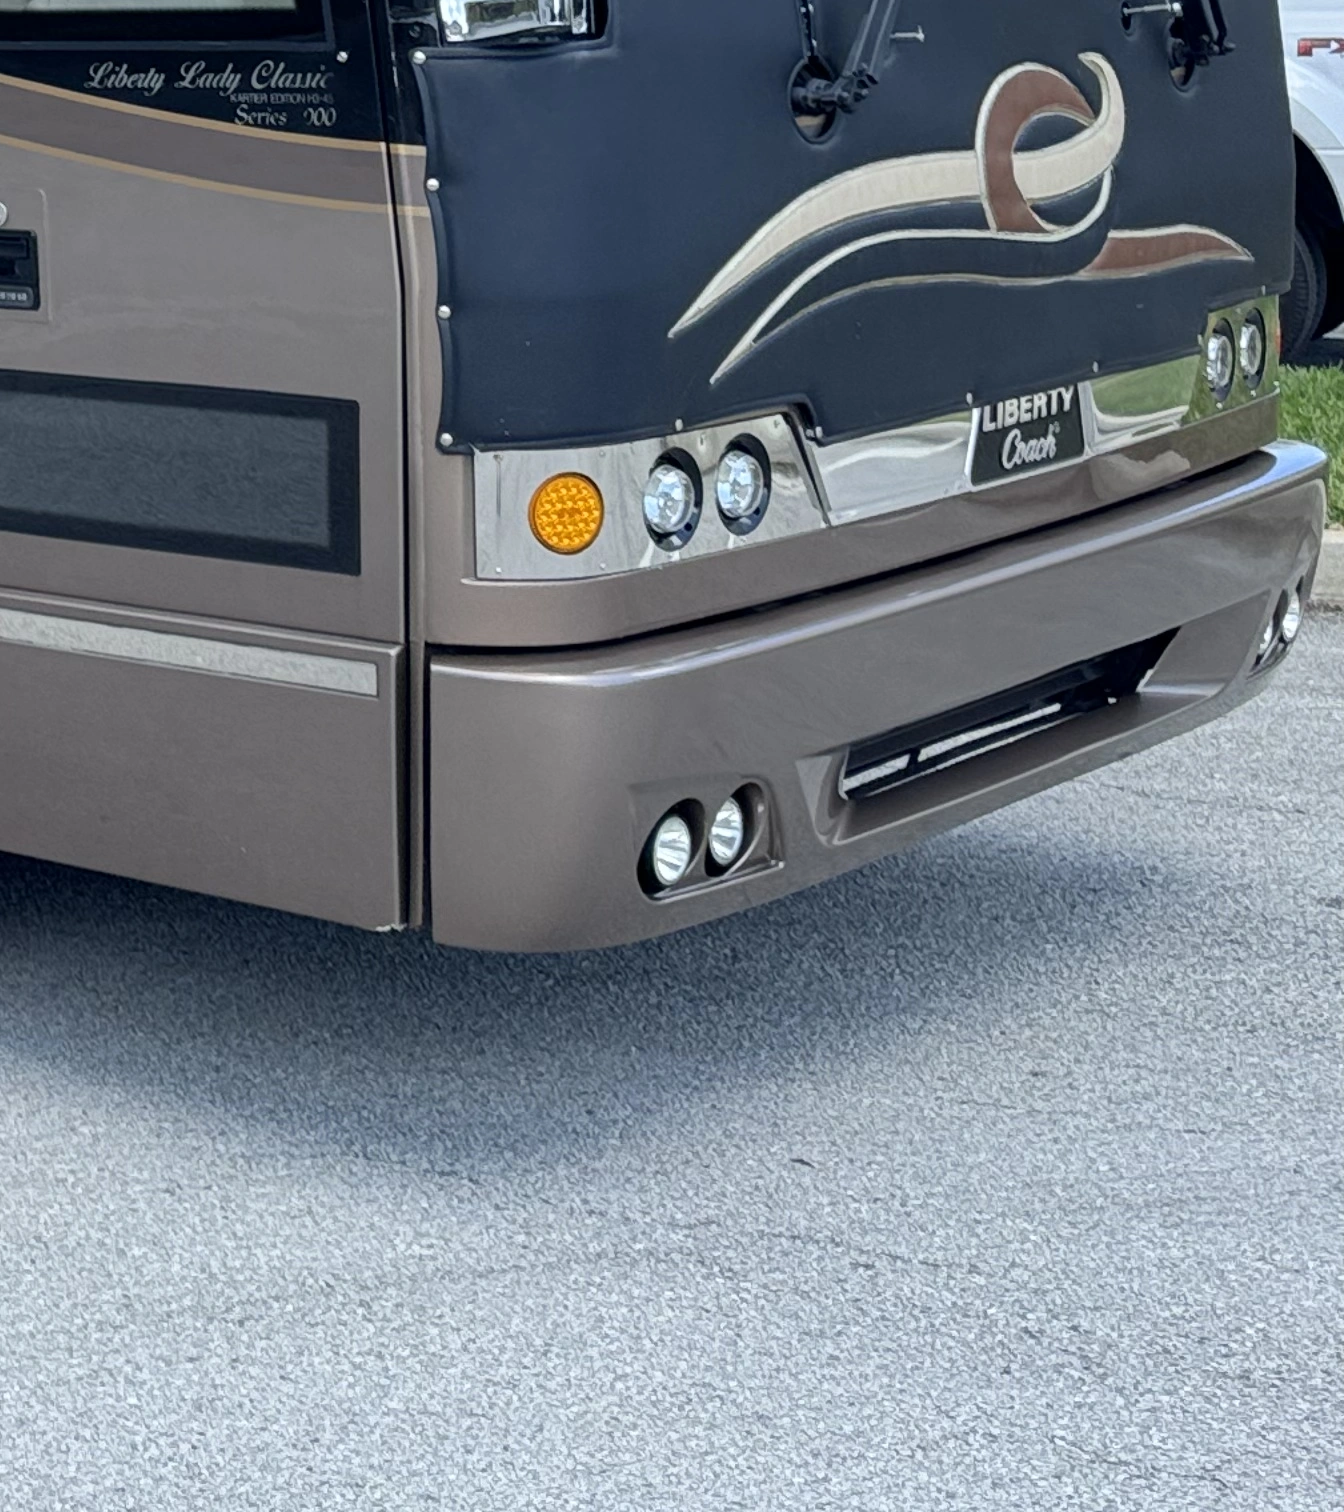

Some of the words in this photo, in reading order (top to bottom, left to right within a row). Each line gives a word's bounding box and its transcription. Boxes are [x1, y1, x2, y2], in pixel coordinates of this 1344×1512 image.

[83, 61, 165, 97] Liberty
[174, 60, 241, 97] Lady
[251, 59, 334, 89] Classic
[234, 104, 288, 125] Series
[982, 385, 1074, 432] LIBERTY
[1002, 424, 1057, 469] Coach
